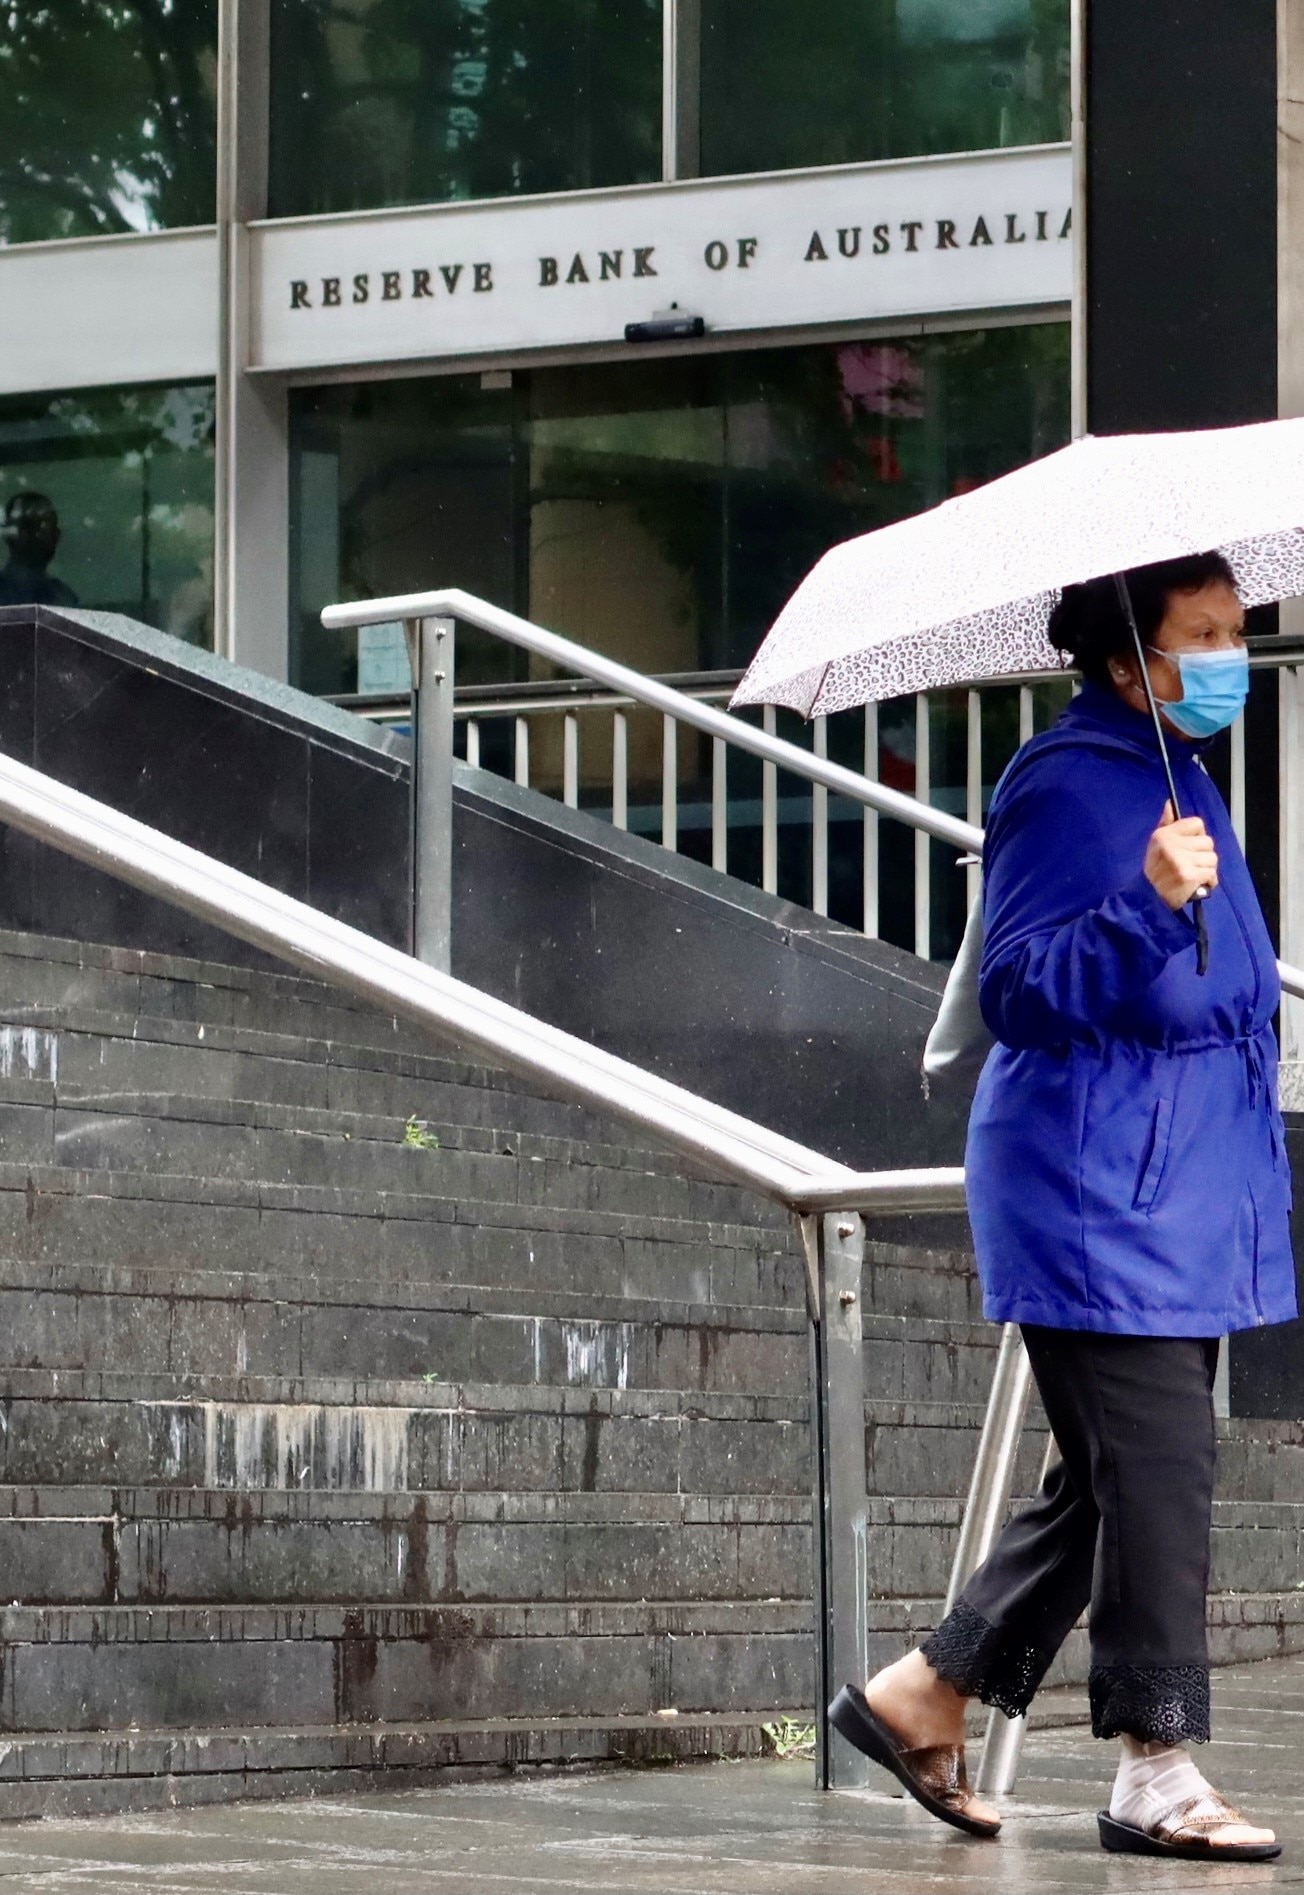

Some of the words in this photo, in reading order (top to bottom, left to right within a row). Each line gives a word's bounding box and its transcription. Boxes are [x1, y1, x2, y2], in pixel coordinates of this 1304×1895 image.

[289, 262, 495, 310] RESERVE
[538, 246, 659, 287] BANK
[704, 237, 759, 271] OF
